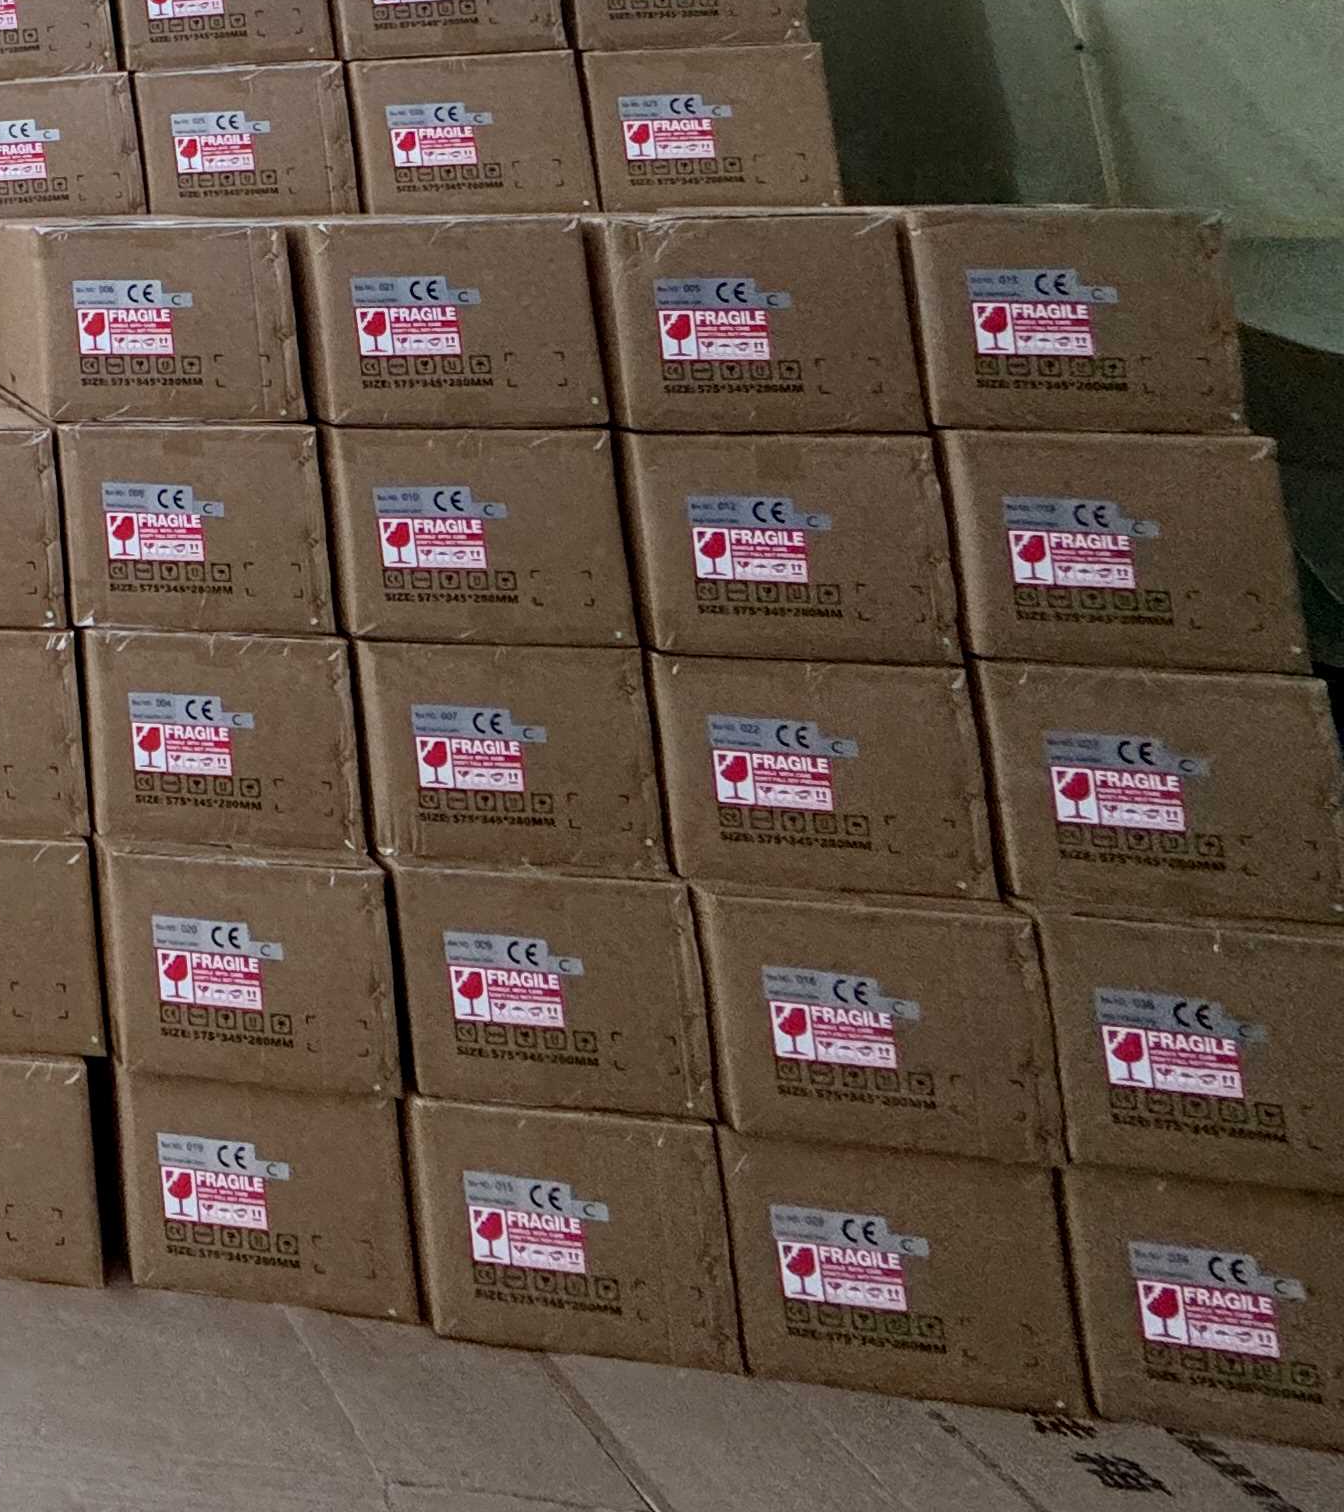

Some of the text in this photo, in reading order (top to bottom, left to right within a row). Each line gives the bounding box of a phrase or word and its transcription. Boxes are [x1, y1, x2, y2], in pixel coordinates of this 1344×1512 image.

[435, 106, 458, 122] CE
[670, 98, 696, 114] CE
[10, 123, 32, 139] CE
[216, 115, 239, 130] CE
[417, 126, 473, 138] FRAGILE
[652, 118, 711, 132] FRAGILE
[201, 132, 251, 146] FRAGILE
[128, 284, 154, 303] CE
[410, 280, 439, 300] CE
[716, 282, 747, 303] CE
[1035, 274, 1069, 295] CE
[109, 308, 170, 322] FRAGILE
[389, 307, 456, 320] FRAGILE
[693, 310, 766, 324] FRAGILE
[1010, 304, 1088, 318] FRAGILE
[158, 489, 184, 509] CE
[434, 491, 464, 512] CE
[137, 513, 201, 529] FRAGILE
[753, 502, 785, 523] CE
[1074, 504, 1108, 528] CE
[412, 518, 482, 534] FRAGILE
[729, 529, 804, 547] FRAGILE
[1048, 532, 1129, 552] FRAGILE
[186, 700, 213, 720] CE
[441, 712, 457, 721] 007
[163, 724, 228, 741] FRAGILE
[473, 713, 502, 734] CE
[449, 738, 520, 756] FRAGILE
[776, 726, 809, 748] CE
[751, 753, 829, 773] FRAGILE
[1118, 741, 1152, 765] CE
[1095, 769, 1180, 791] FRAGILE
[212, 927, 240, 949] CE
[191, 952, 258, 972] FRAGILE
[508, 941, 538, 966] CE
[485, 969, 559, 989] FRAGILE
[833, 980, 868, 1005] CE
[809, 1007, 892, 1029] FRAGILE
[1173, 1002, 1213, 1030] CE
[1148, 1032, 1236, 1056] FRAGILE
[218, 1145, 246, 1168] CE
[197, 1168, 263, 1193] FRAGILE
[530, 1185, 562, 1211] CE
[507, 1211, 580, 1234] FRAGILE
[842, 1219, 878, 1245] CE
[819, 1245, 900, 1269] FRAGILE
[1208, 1257, 1247, 1285] CE
[1184, 1287, 1273, 1315] FRAGILE
